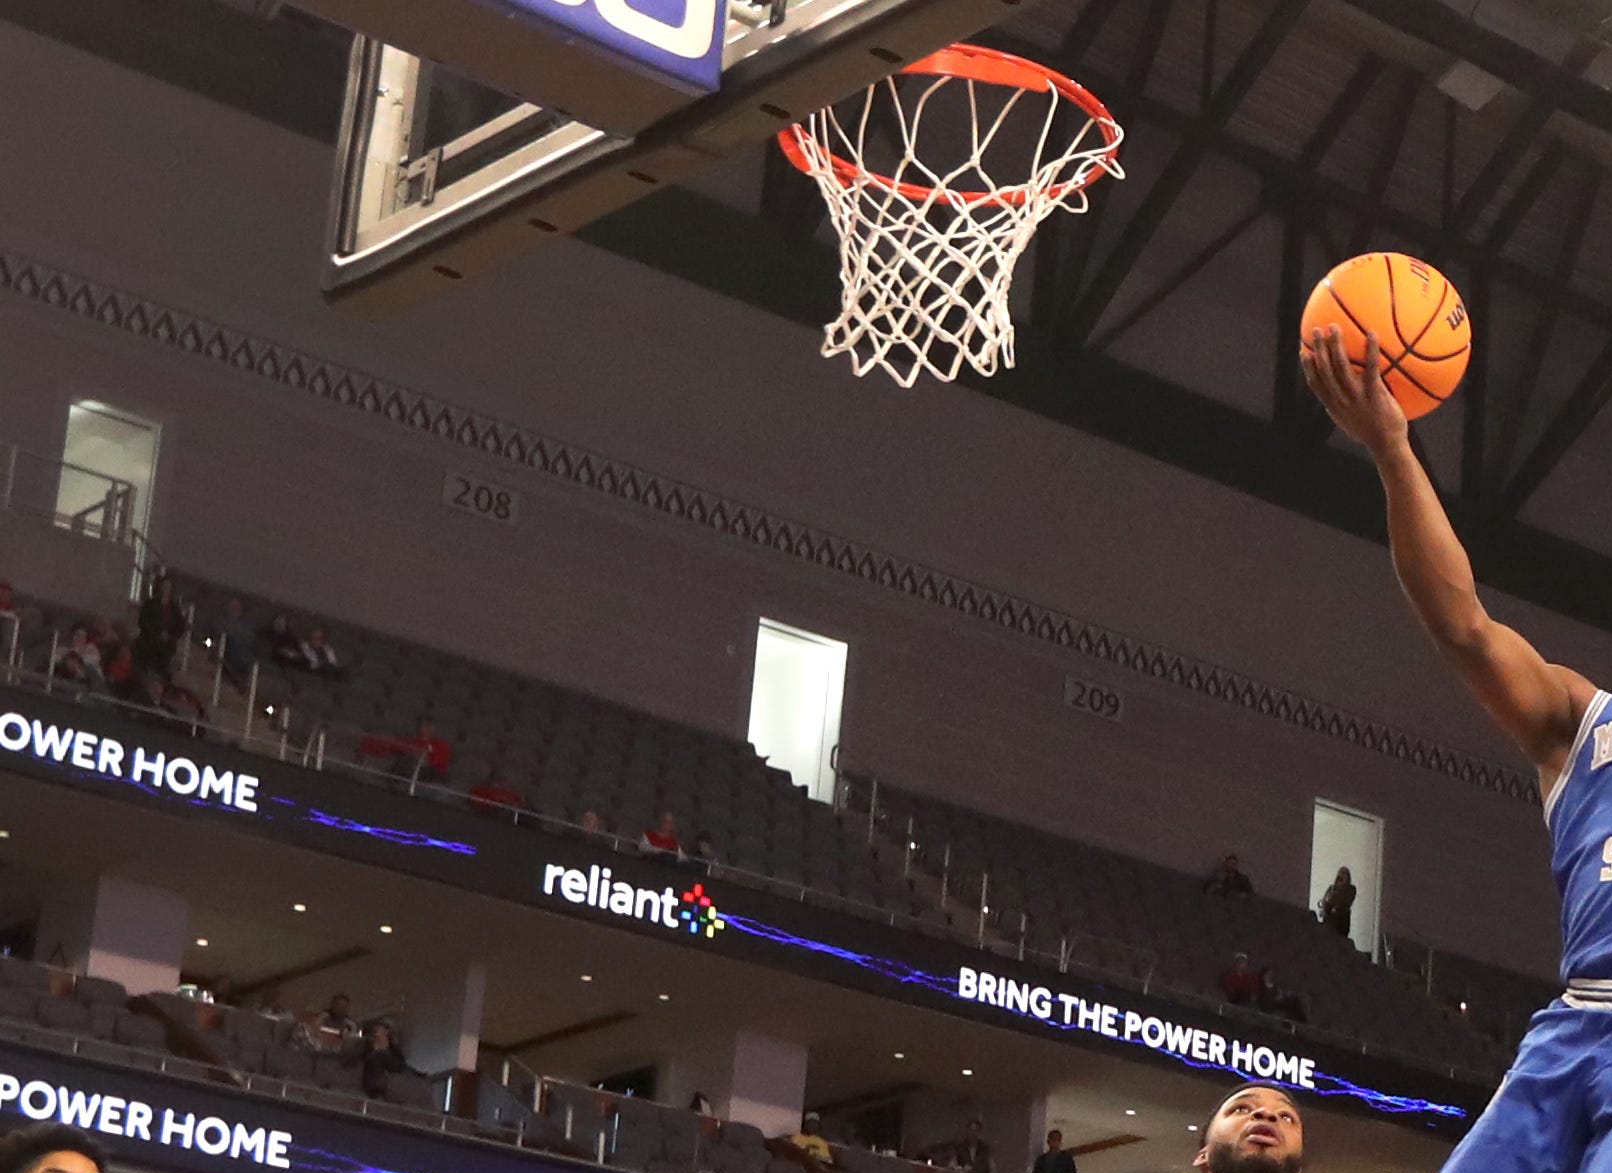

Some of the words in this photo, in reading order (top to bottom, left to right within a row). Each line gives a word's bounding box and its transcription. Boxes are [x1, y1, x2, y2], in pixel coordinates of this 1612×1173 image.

[452, 477, 512, 519] 208
[1072, 681, 1119, 717] 209
[132, 747, 259, 812] HOME
[543, 863, 680, 928] reliant
[958, 966, 1052, 1019] BRING
[1058, 993, 1119, 1038] THE
[1123, 1010, 1227, 1066] POWER
[1231, 1039, 1316, 1089] HOME
[160, 1108, 292, 1169] HOME
